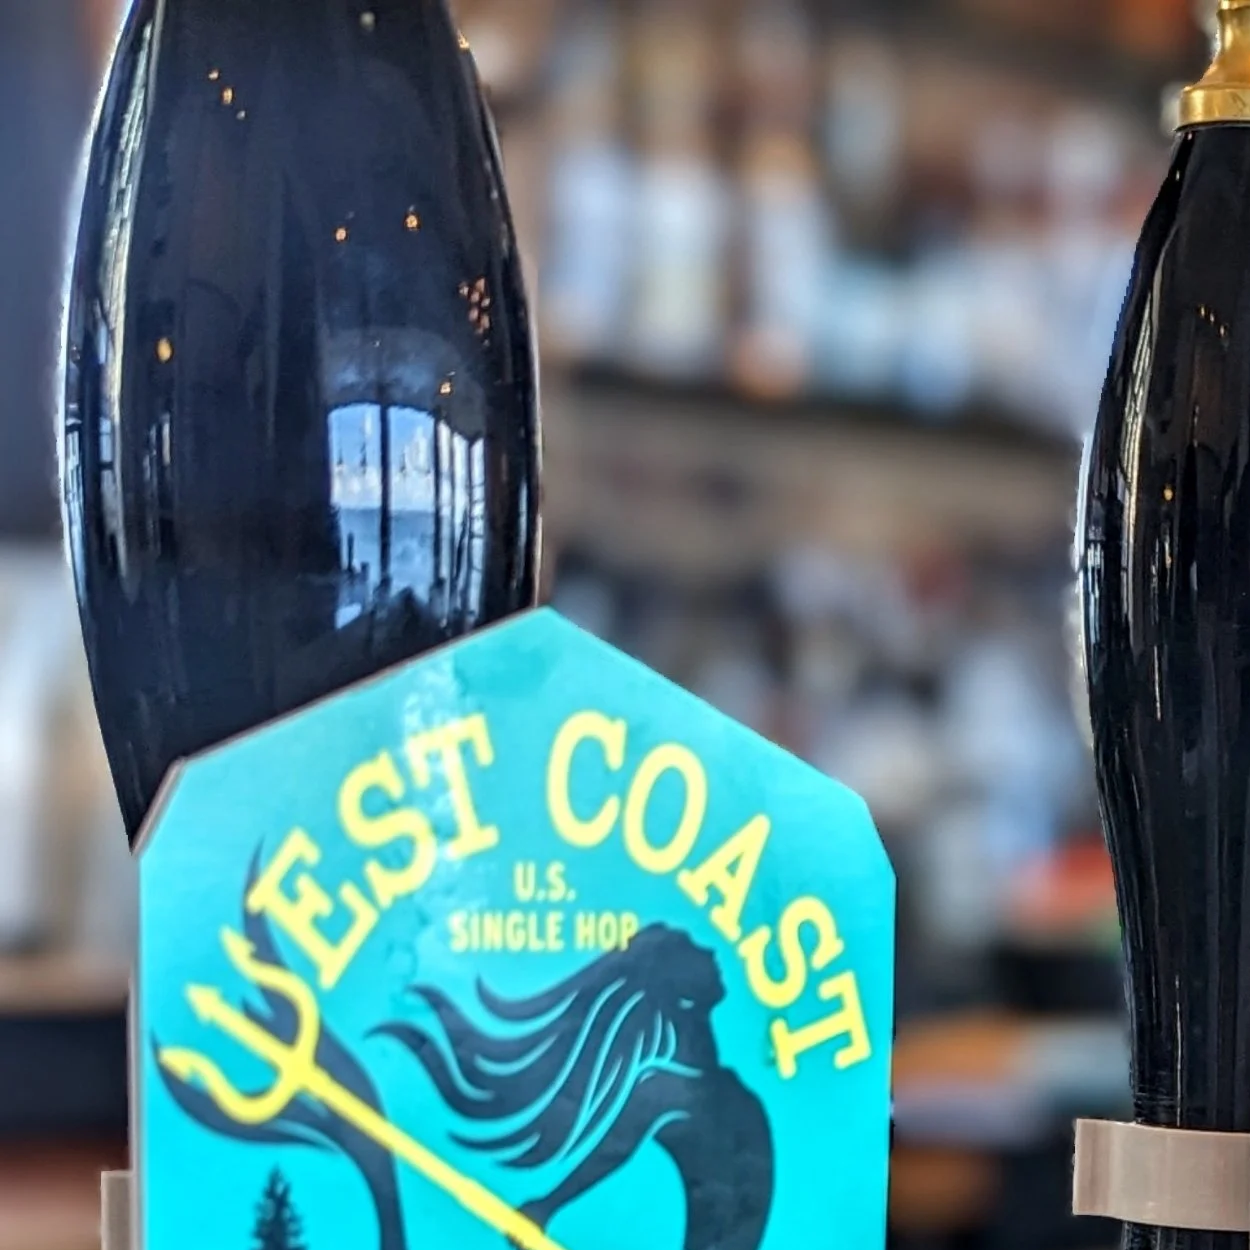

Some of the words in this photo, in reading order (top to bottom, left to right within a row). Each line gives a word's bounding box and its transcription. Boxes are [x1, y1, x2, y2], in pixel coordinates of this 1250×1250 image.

[514, 863, 576, 902] U.S.
[546, 710, 873, 1079] COAST
[450, 911, 565, 952] SINGLE
[576, 911, 637, 952] HOP
